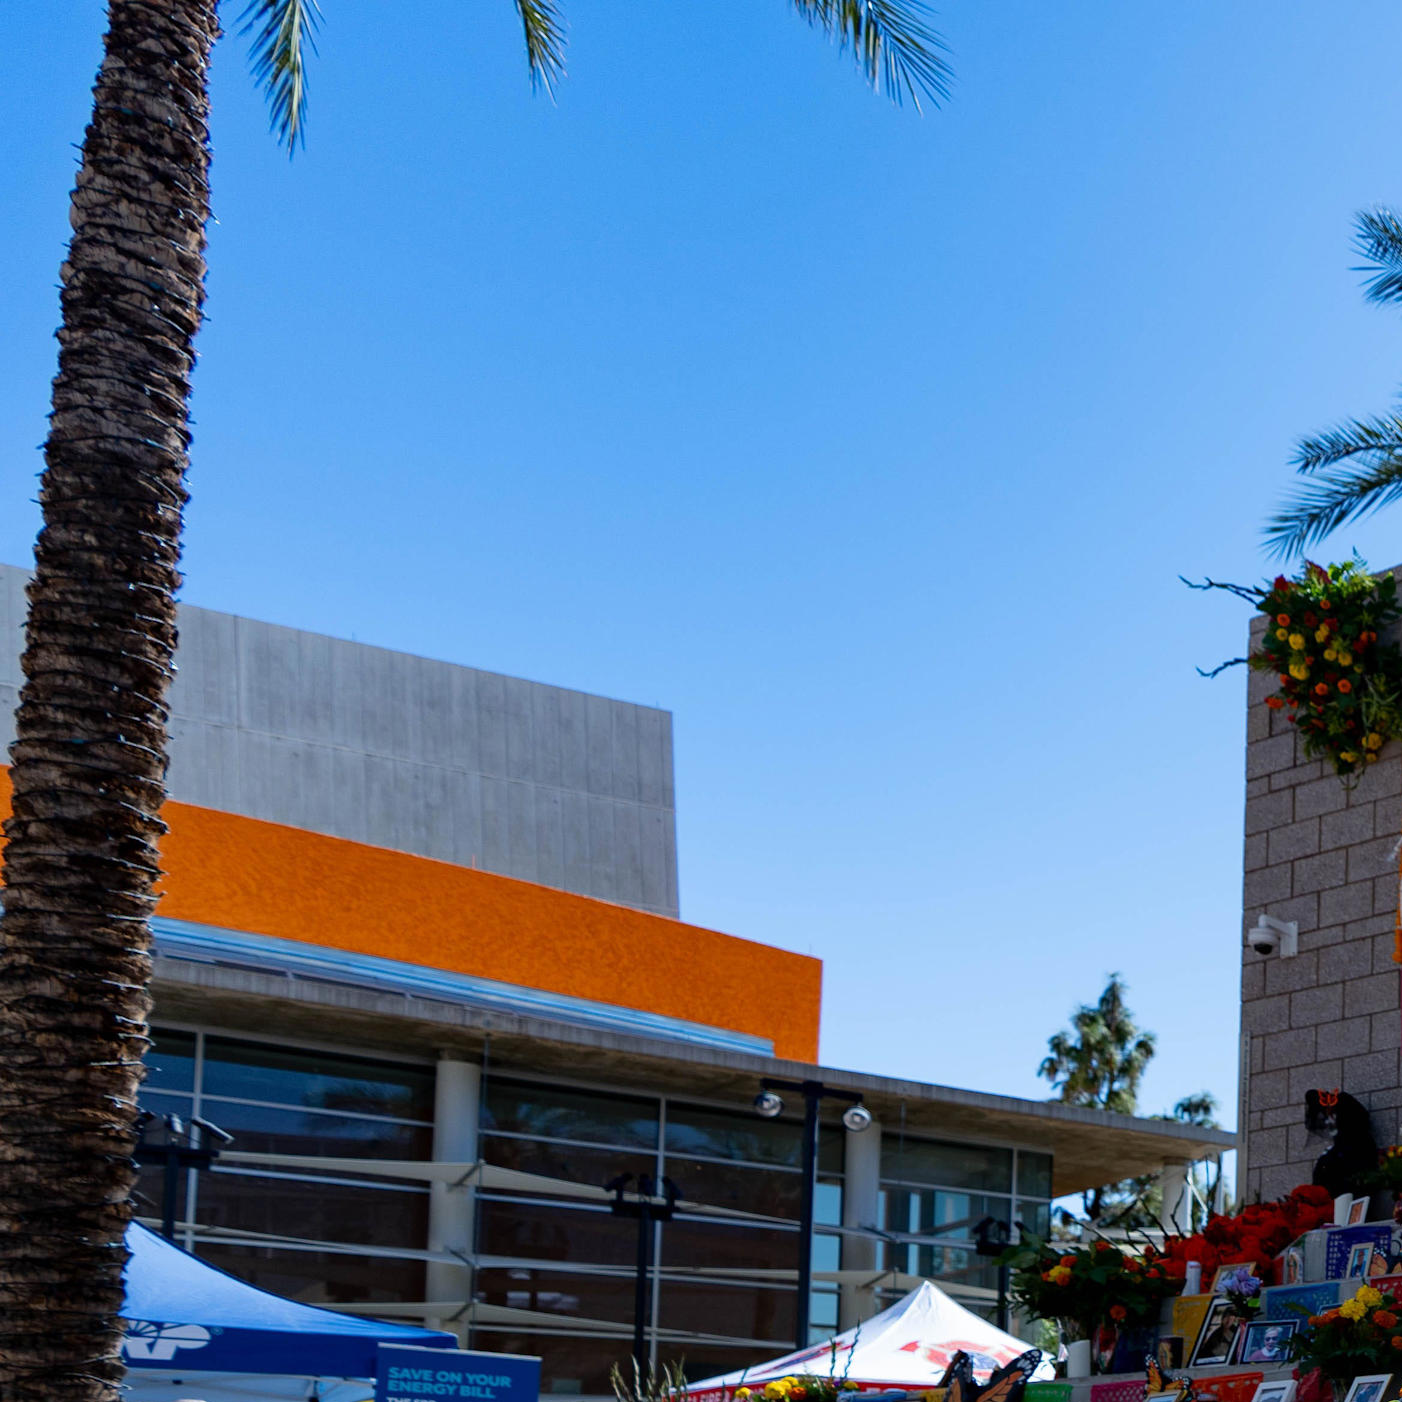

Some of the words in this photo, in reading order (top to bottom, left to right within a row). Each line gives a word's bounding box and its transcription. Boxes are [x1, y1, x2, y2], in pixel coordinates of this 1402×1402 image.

[388, 1366, 433, 1382] SAVE
[436, 1370, 462, 1384] ON
[465, 1372, 512, 1388] YOUR
[387, 1379, 457, 1395] ENERGY
[459, 1385, 496, 1399] BILL
